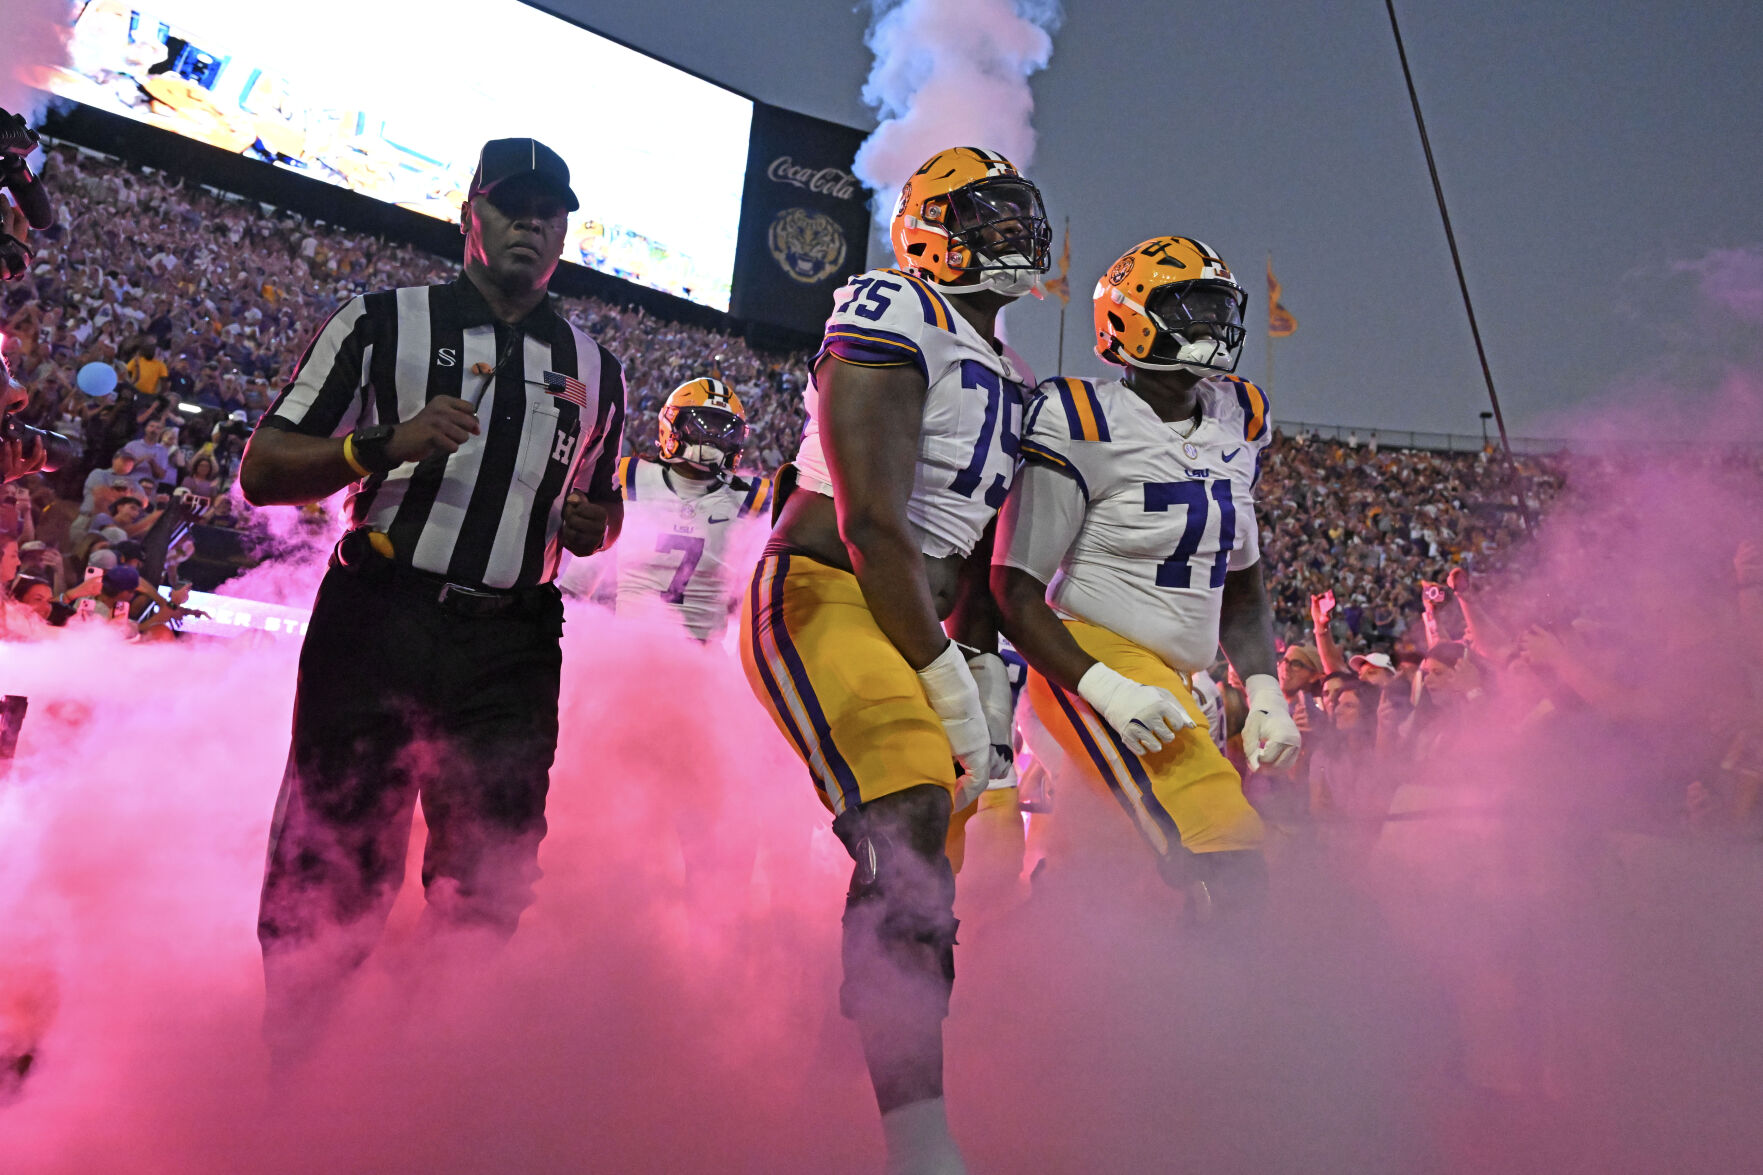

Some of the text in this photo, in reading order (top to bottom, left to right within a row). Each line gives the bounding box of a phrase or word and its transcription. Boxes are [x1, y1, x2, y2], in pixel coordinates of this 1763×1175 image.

[768, 156, 856, 200] Coca-Cola
[837, 277, 902, 322] 75
[437, 348, 456, 367] S
[552, 430, 576, 465] H
[948, 359, 1023, 510] 75
[1185, 468, 1209, 478] LSU
[673, 525, 694, 534] LSU
[1144, 479, 1236, 589] 71
[656, 533, 704, 604] 7
